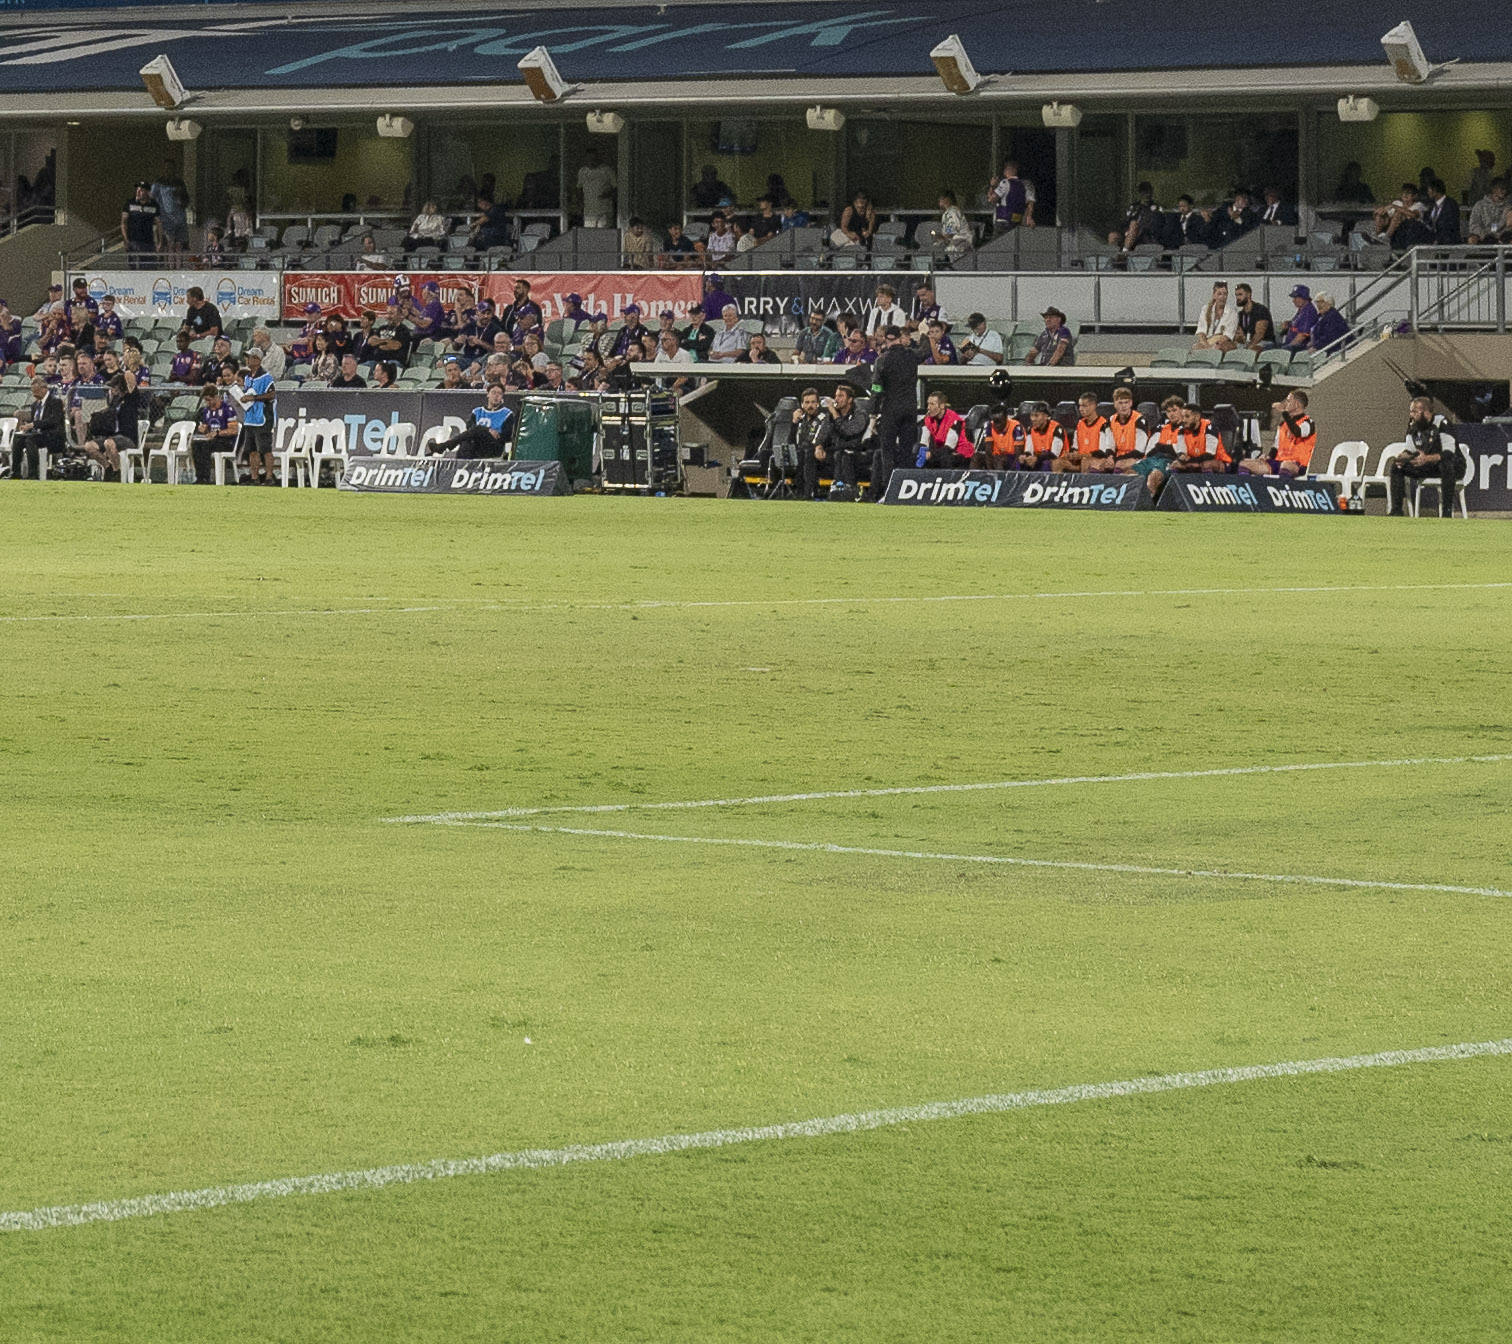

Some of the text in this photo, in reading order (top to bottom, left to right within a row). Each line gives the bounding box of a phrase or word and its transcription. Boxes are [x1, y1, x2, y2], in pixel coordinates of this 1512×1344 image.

[291, 287, 338, 304] SUMICH
[275, 407, 400, 452] rimTel
[350, 464, 435, 488] DrimTel
[451, 466, 546, 492] DrimTel
[897, 476, 1003, 505] DrimTel
[1023, 480, 1128, 507] DrimTel
[1187, 479, 1259, 507] DrimTel
[1267, 484, 1336, 512] DrimTel
